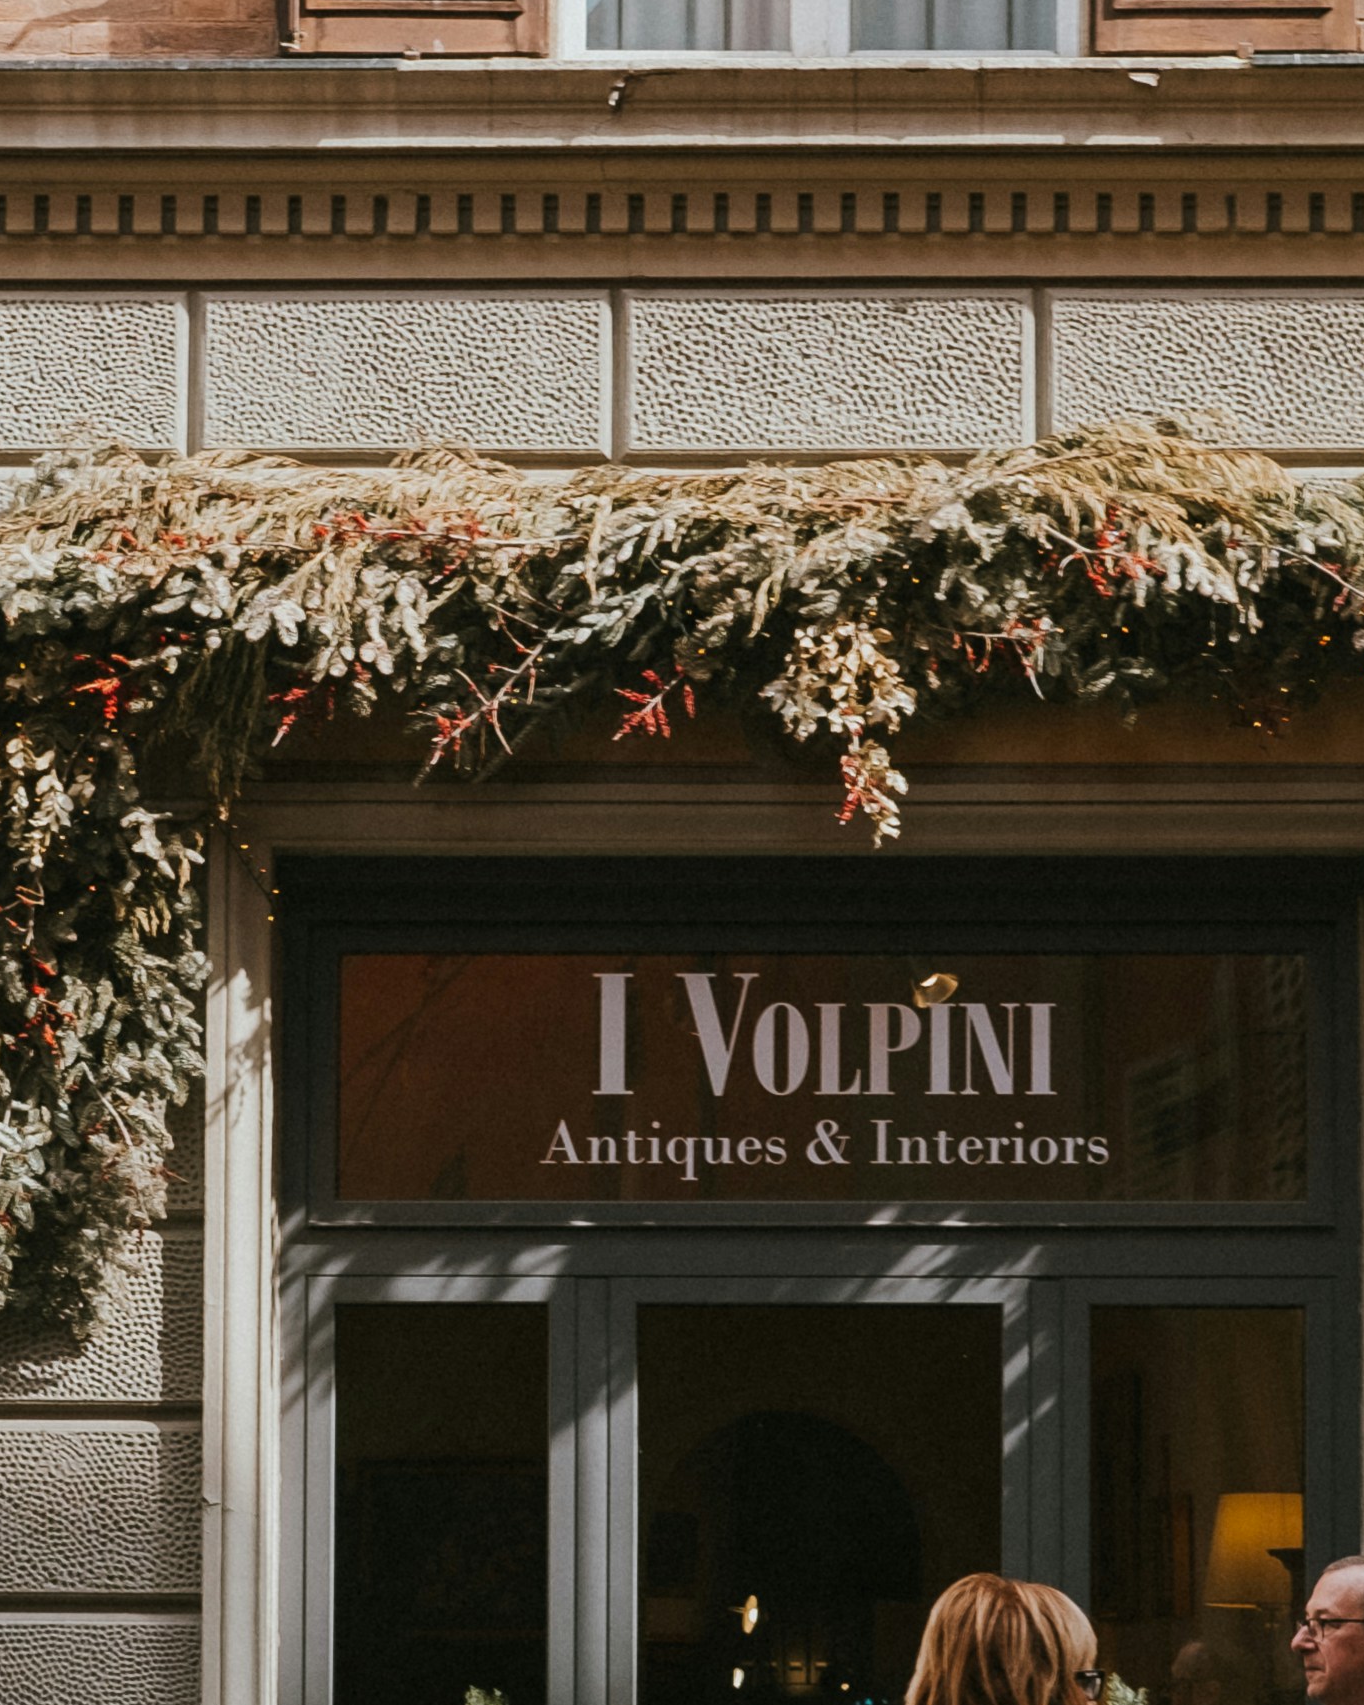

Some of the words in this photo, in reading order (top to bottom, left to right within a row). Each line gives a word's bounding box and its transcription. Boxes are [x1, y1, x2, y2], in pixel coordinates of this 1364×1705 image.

[591, 972, 635, 1095] I
[674, 972, 1058, 1096] VOLPINI
[538, 1118, 788, 1181] Antiques
[805, 1118, 851, 1165] &
[868, 1119, 1110, 1165] Interiors
